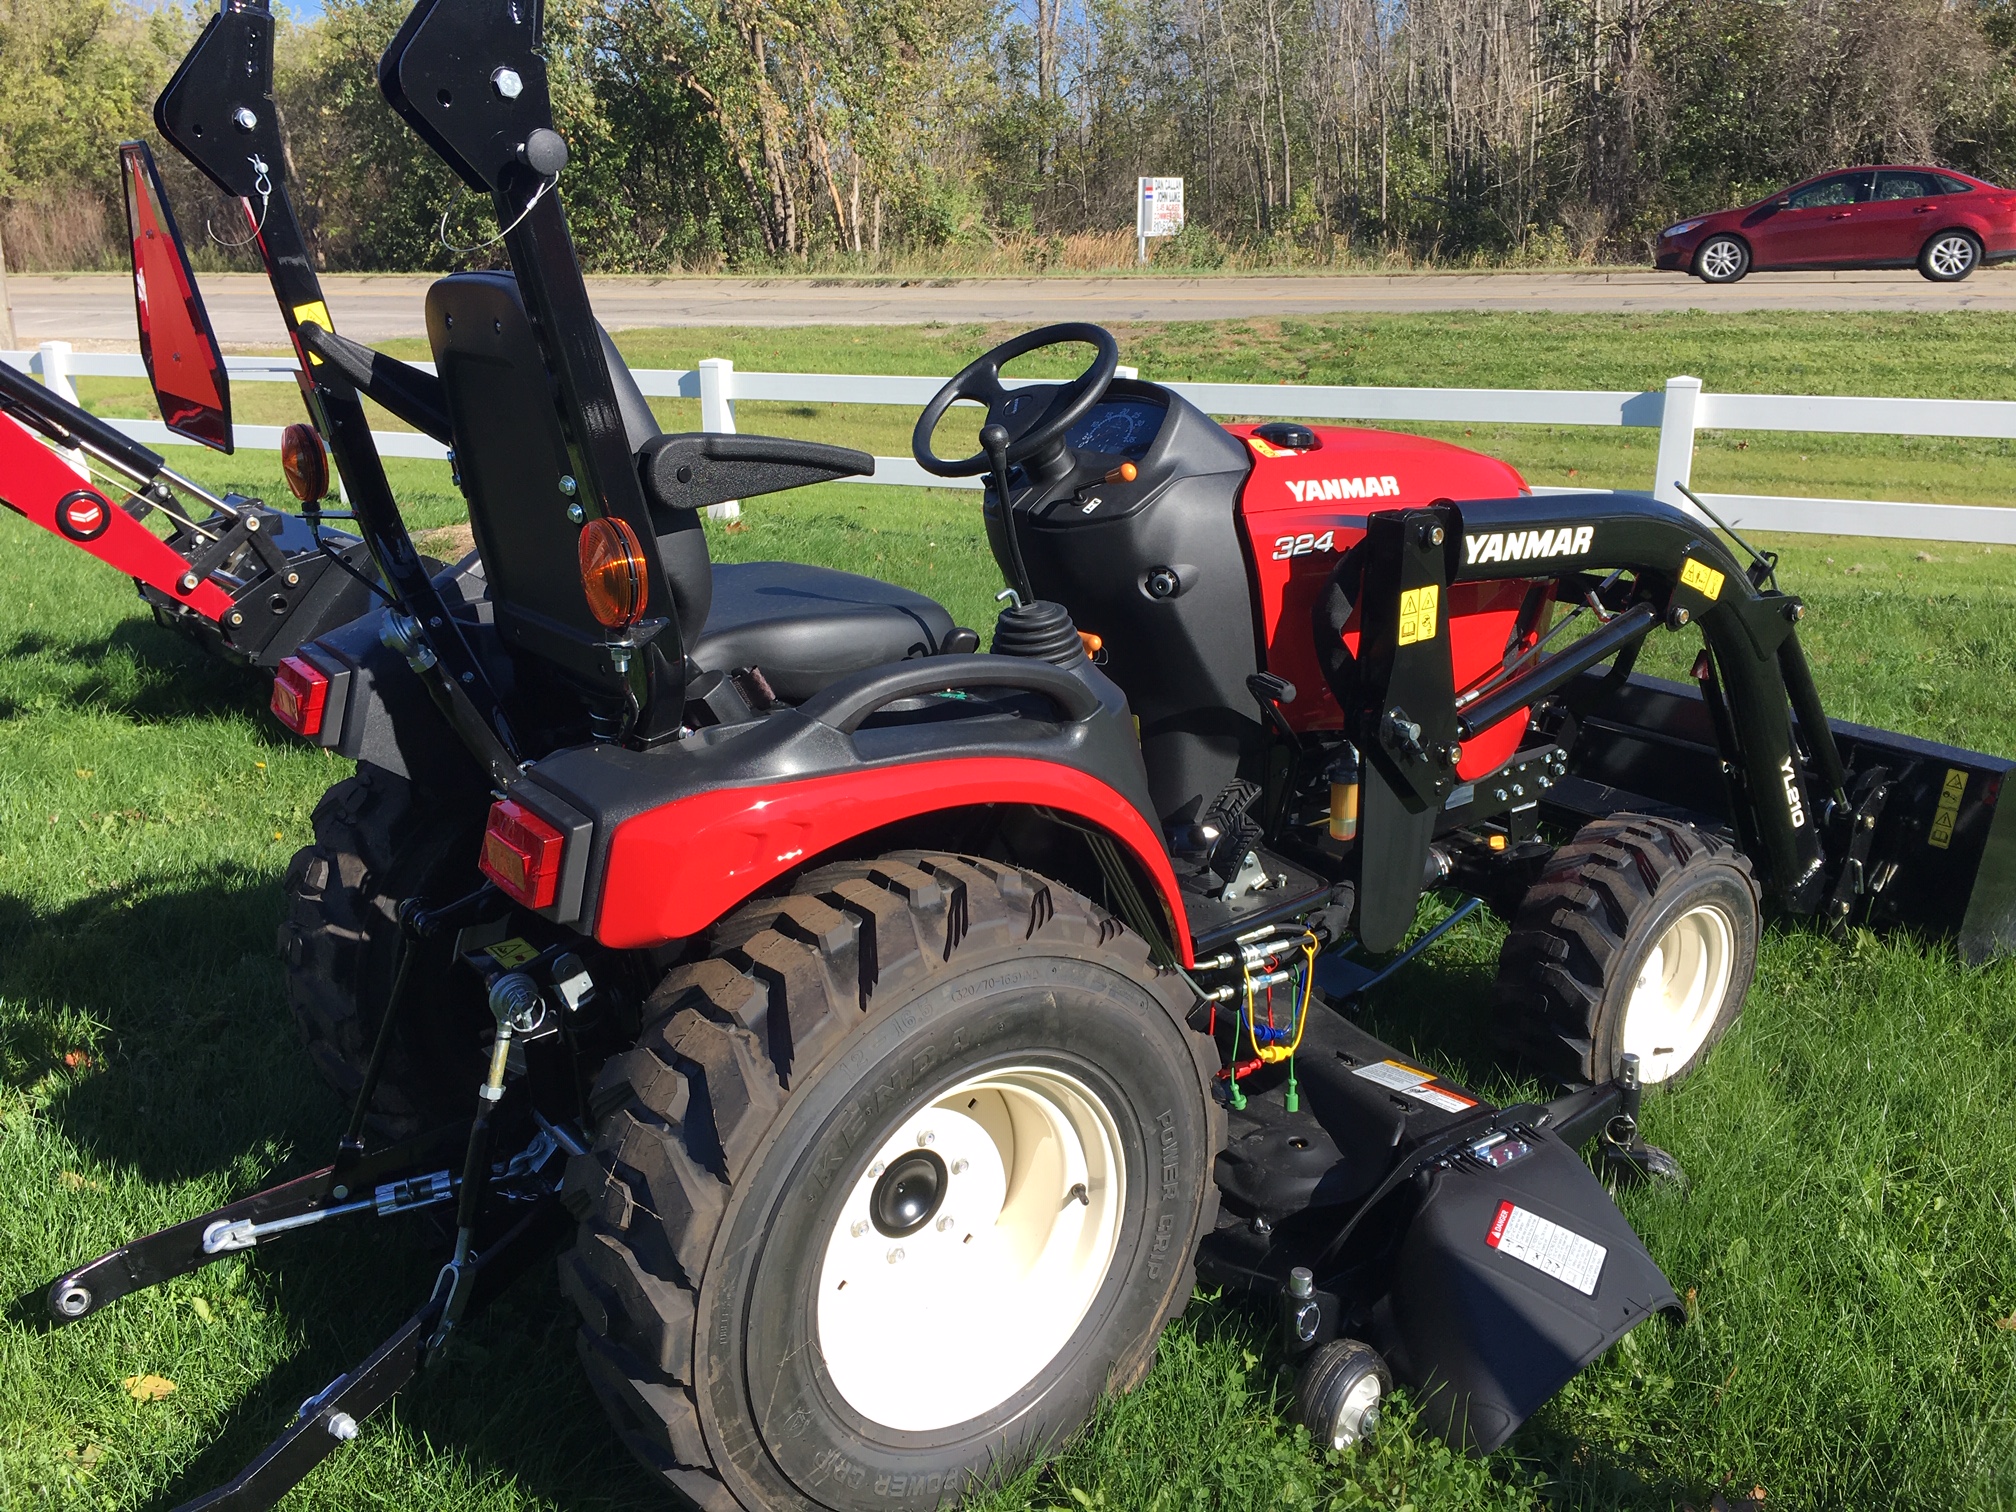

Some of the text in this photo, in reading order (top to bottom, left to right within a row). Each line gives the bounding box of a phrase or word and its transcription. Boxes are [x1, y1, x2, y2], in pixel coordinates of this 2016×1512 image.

[1285, 475, 1400, 502] YANMAR
[1272, 529, 1335, 561] 324
[1464, 525, 1595, 565] YANMAR
[1781, 756, 1805, 828] YL210
[811, 1025, 974, 1190] KENDA
[1147, 1108, 1180, 1281] POWER GRIP
[1495, 1209, 1509, 1233] DANGER
[813, 1448, 959, 1498] POWER GRIP
